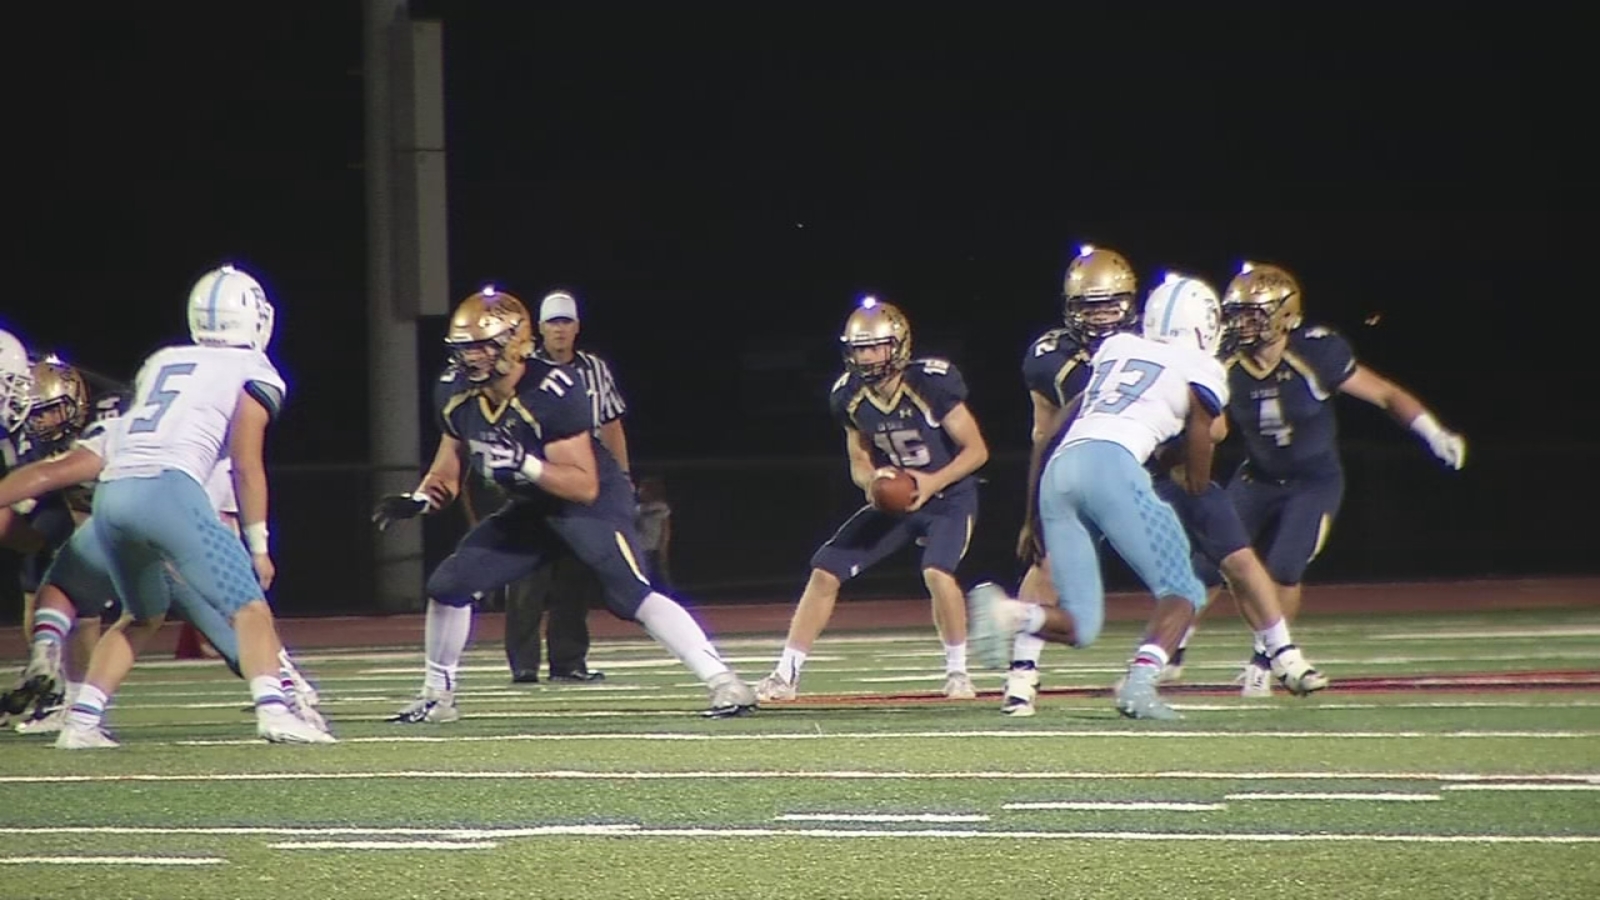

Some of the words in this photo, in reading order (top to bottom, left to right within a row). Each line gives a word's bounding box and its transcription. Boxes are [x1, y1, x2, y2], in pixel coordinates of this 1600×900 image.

[128, 362, 199, 434] 5
[539, 367, 574, 398] 77
[1079, 358, 1165, 419] 13
[1259, 397, 1293, 447] 4
